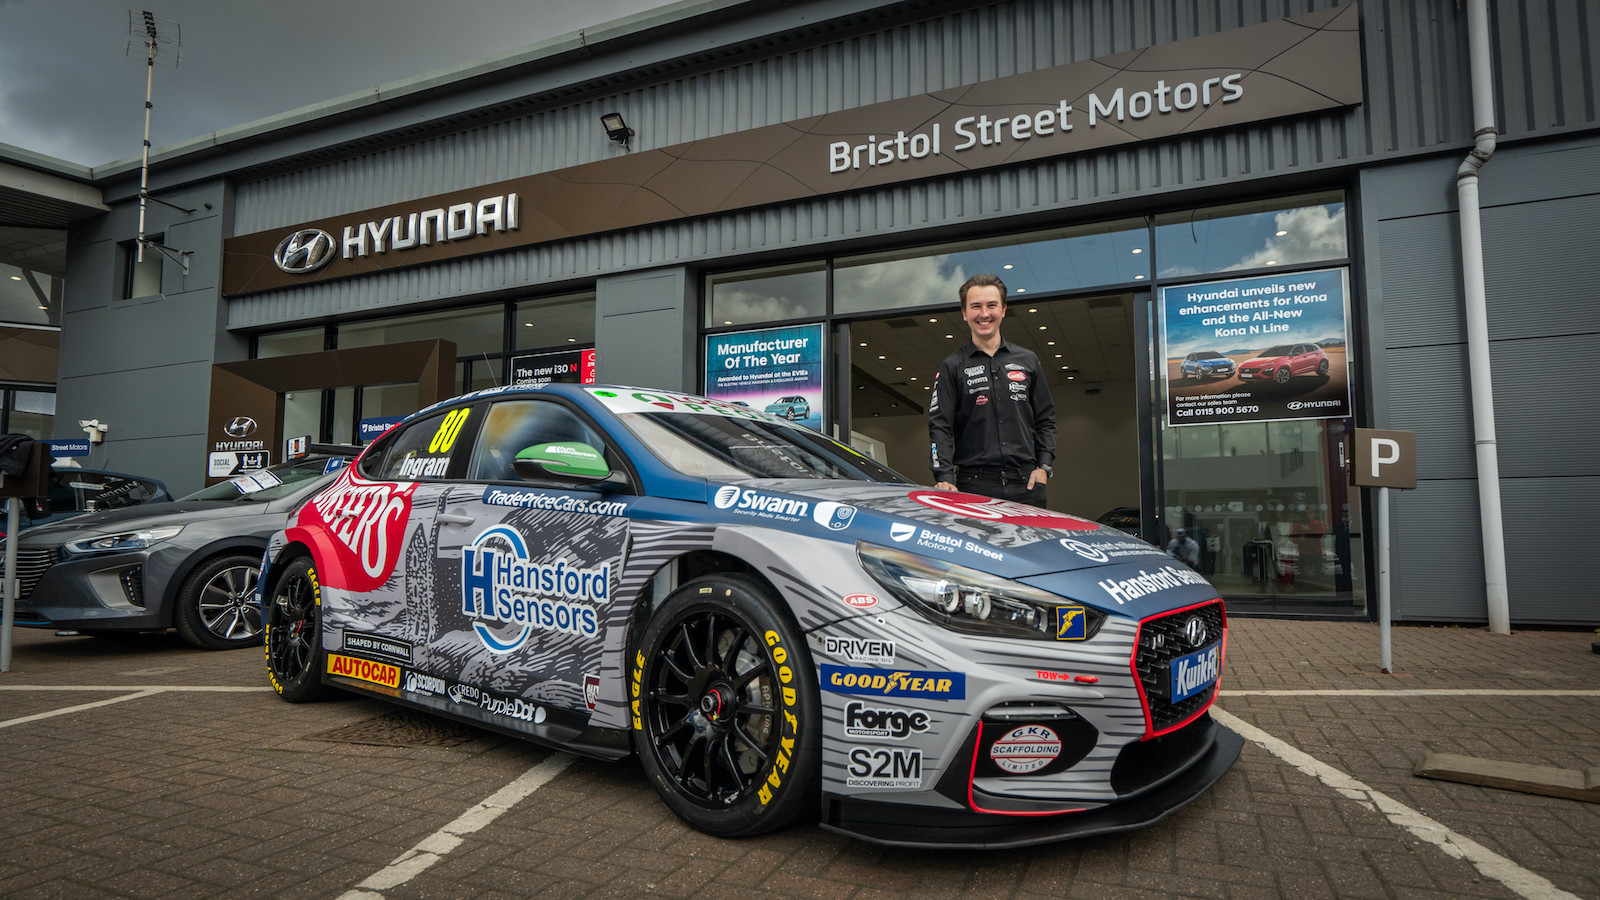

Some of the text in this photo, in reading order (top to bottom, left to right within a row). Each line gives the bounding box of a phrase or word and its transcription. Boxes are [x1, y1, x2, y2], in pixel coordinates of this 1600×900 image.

[829, 73, 1244, 173] Bristol Street Motors
[342, 192, 519, 260] HYUNDAI
[1187, 281, 1316, 303] Hyundai unveils new
[1179, 293, 1328, 316] enhancements for Kona
[1202, 308, 1303, 326] and the All-New
[1215, 322, 1289, 338] Kona N Line
[717, 338, 809, 356] Manufacturer
[724, 352, 801, 369] Of The Year
[516, 368, 533, 378] The
[534, 366, 553, 376] new
[554, 364, 569, 374] i30
[570, 363, 578, 373] N
[717, 369, 809, 383] Awarded to Hyundai at the EVIEs
[516, 377, 537, 385] Coming
[1200, 392, 1231, 400] information
[1303, 400, 1342, 408] HYUNDAI
[1176, 405, 1259, 417] Call 0115 900 5670
[368, 423, 384, 432] Bristol
[429, 407, 471, 454] 80
[69, 443, 88, 451] Motors
[215, 440, 264, 451] HYUNDAI
[213, 458, 231, 466] SOCIAL
[398, 453, 451, 480] Ingram
[1370, 437, 1400, 478] P
[487, 490, 628, 516] TradePriceCars.com
[737, 489, 809, 517] Swann
[733, 508, 801, 523] Security Made Smarter
[916, 538, 955, 553] Motors
[920, 529, 1004, 562] Bristol Street
[307, 567, 321, 607] EAGLE
[497, 554, 610, 602] Hansford
[1098, 567, 1182, 605] Hansford
[849, 595, 874, 606] ABS
[497, 588, 598, 637] Sensors
[347, 637, 410, 657] SHAPED BY CORNWALL
[827, 638, 893, 660] DRIVEN
[332, 659, 397, 686] AUTOCAR
[1036, 670, 1058, 680] TOW
[417, 673, 446, 695] SCORPION
[457, 683, 480, 699] CREDO
[631, 649, 646, 731] EAGLE
[480, 692, 535, 722] PurpleDot
[846, 703, 930, 737] forge
[1011, 725, 1051, 739] GKR
[993, 744, 1061, 755] SCAFFOLDING
[849, 749, 921, 778] S2M
[1002, 759, 1044, 771] LIMITED
[848, 779, 895, 787] DISCOVERING
